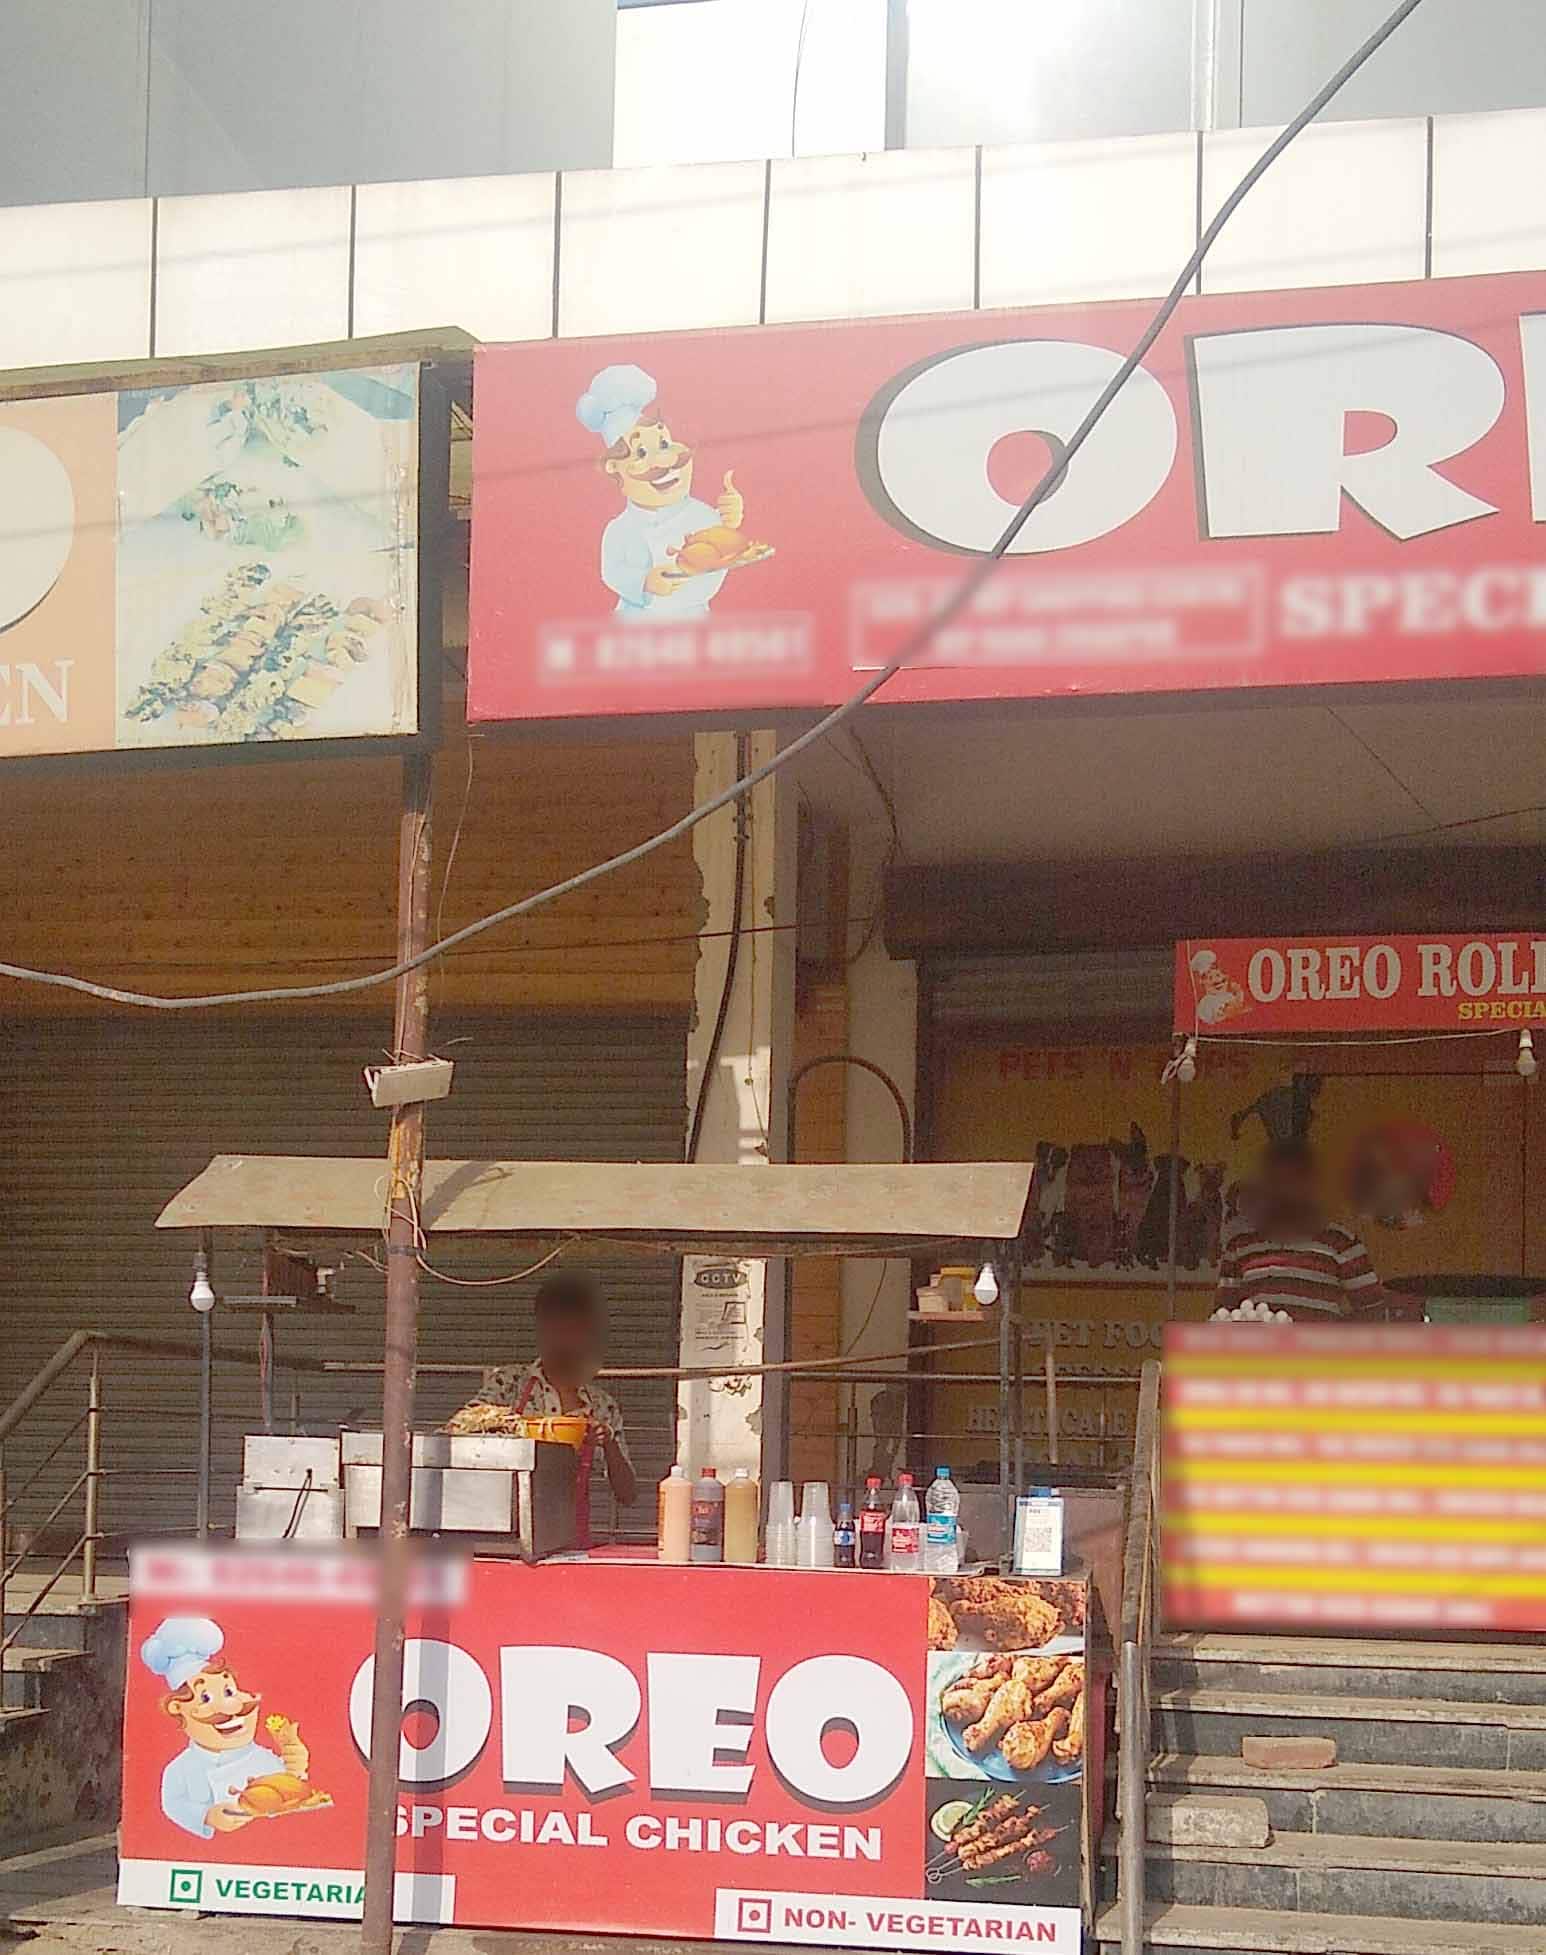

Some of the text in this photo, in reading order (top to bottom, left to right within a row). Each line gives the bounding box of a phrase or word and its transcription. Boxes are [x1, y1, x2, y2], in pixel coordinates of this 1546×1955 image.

[866, 313, 1546, 554] OR
[1247, 943, 1402, 1002] OREO
[1458, 1000, 1546, 1020] SPECIA
[700, 1273, 742, 1284] CCTV
[348, 1637, 914, 1808] OREO
[625, 1813, 882, 1861] CHICKEN
[215, 1878, 366, 1905] VEGETARIA
[784, 1907, 1057, 1942] NON- VEGETARIAN
